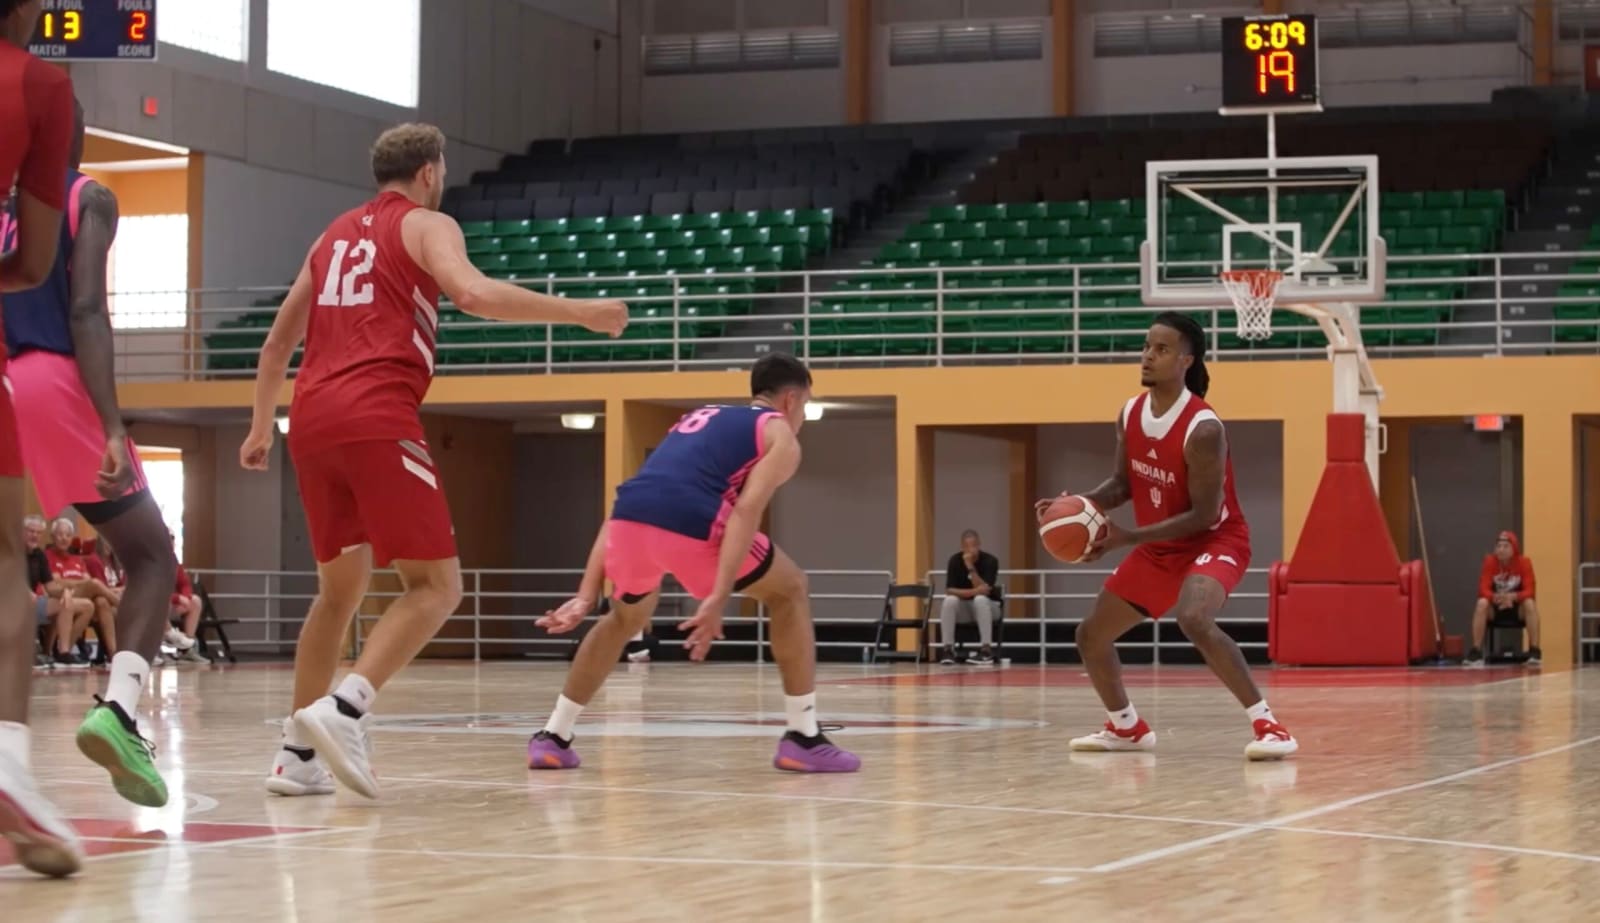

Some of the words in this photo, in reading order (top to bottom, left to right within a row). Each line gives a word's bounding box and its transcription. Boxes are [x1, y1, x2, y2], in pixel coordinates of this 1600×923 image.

[130, 12, 146, 39] 2
[1245, 21, 1305, 50] 6:09
[29, 45, 66, 56] MATCH
[118, 45, 152, 56] SCORE
[1260, 51, 1294, 93] 19
[317, 238, 377, 307] 12
[1131, 459, 1176, 484] INDIANA
